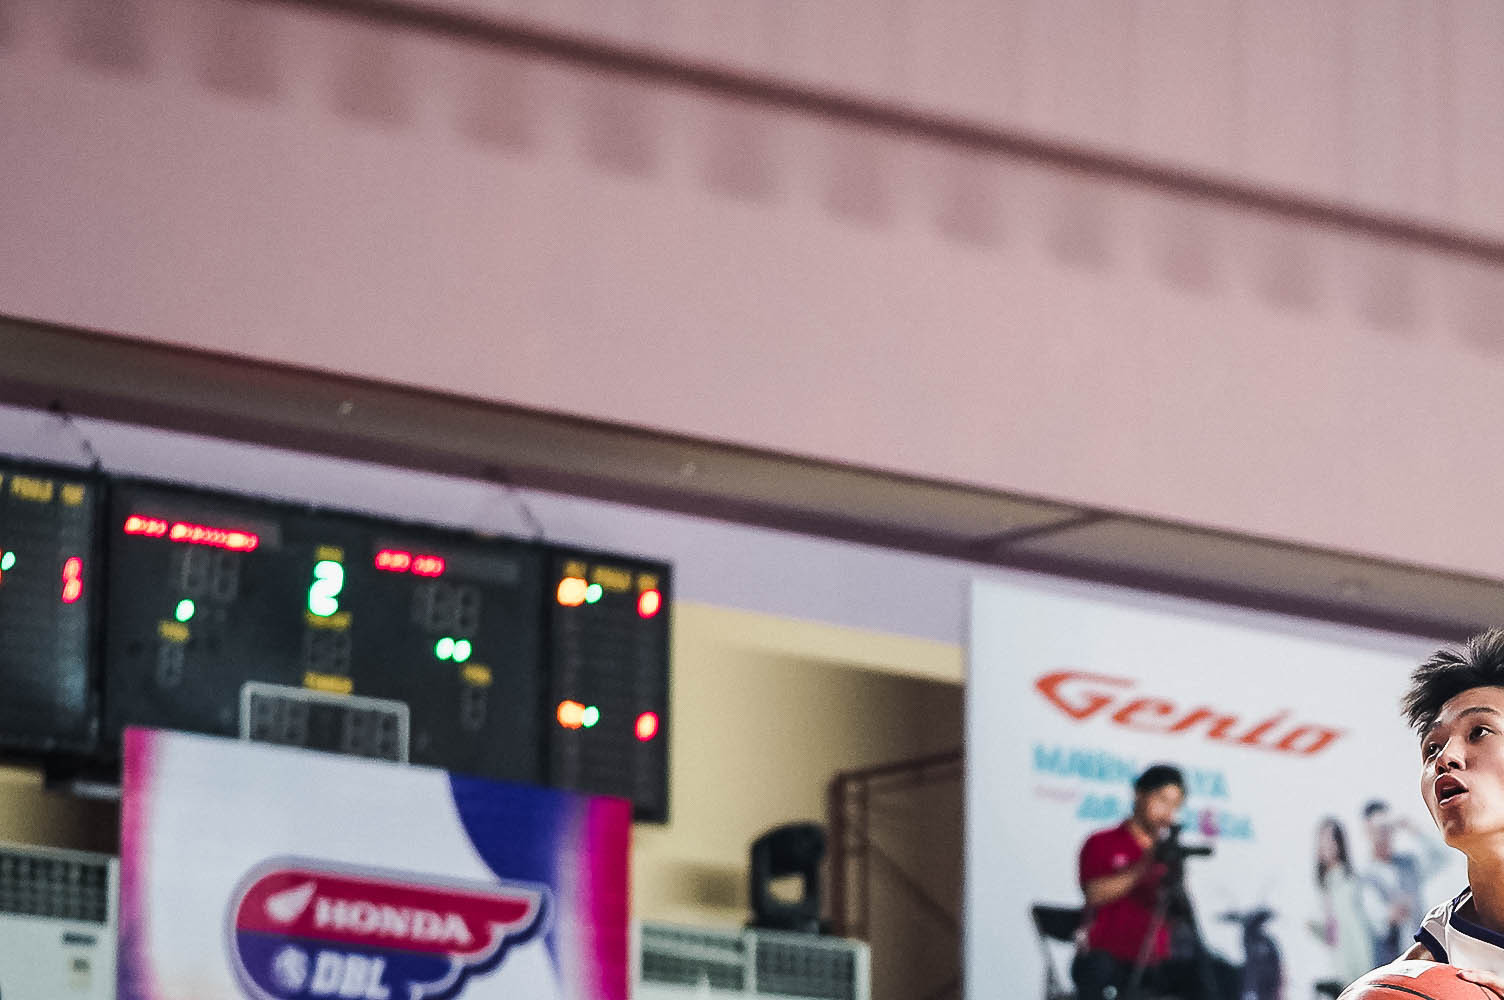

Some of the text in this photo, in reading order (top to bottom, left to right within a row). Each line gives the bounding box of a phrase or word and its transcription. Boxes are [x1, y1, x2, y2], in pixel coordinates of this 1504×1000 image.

[1033, 669, 1350, 757] Genio
[315, 897, 474, 945] HONDA
[312, 949, 391, 1000] DBL
